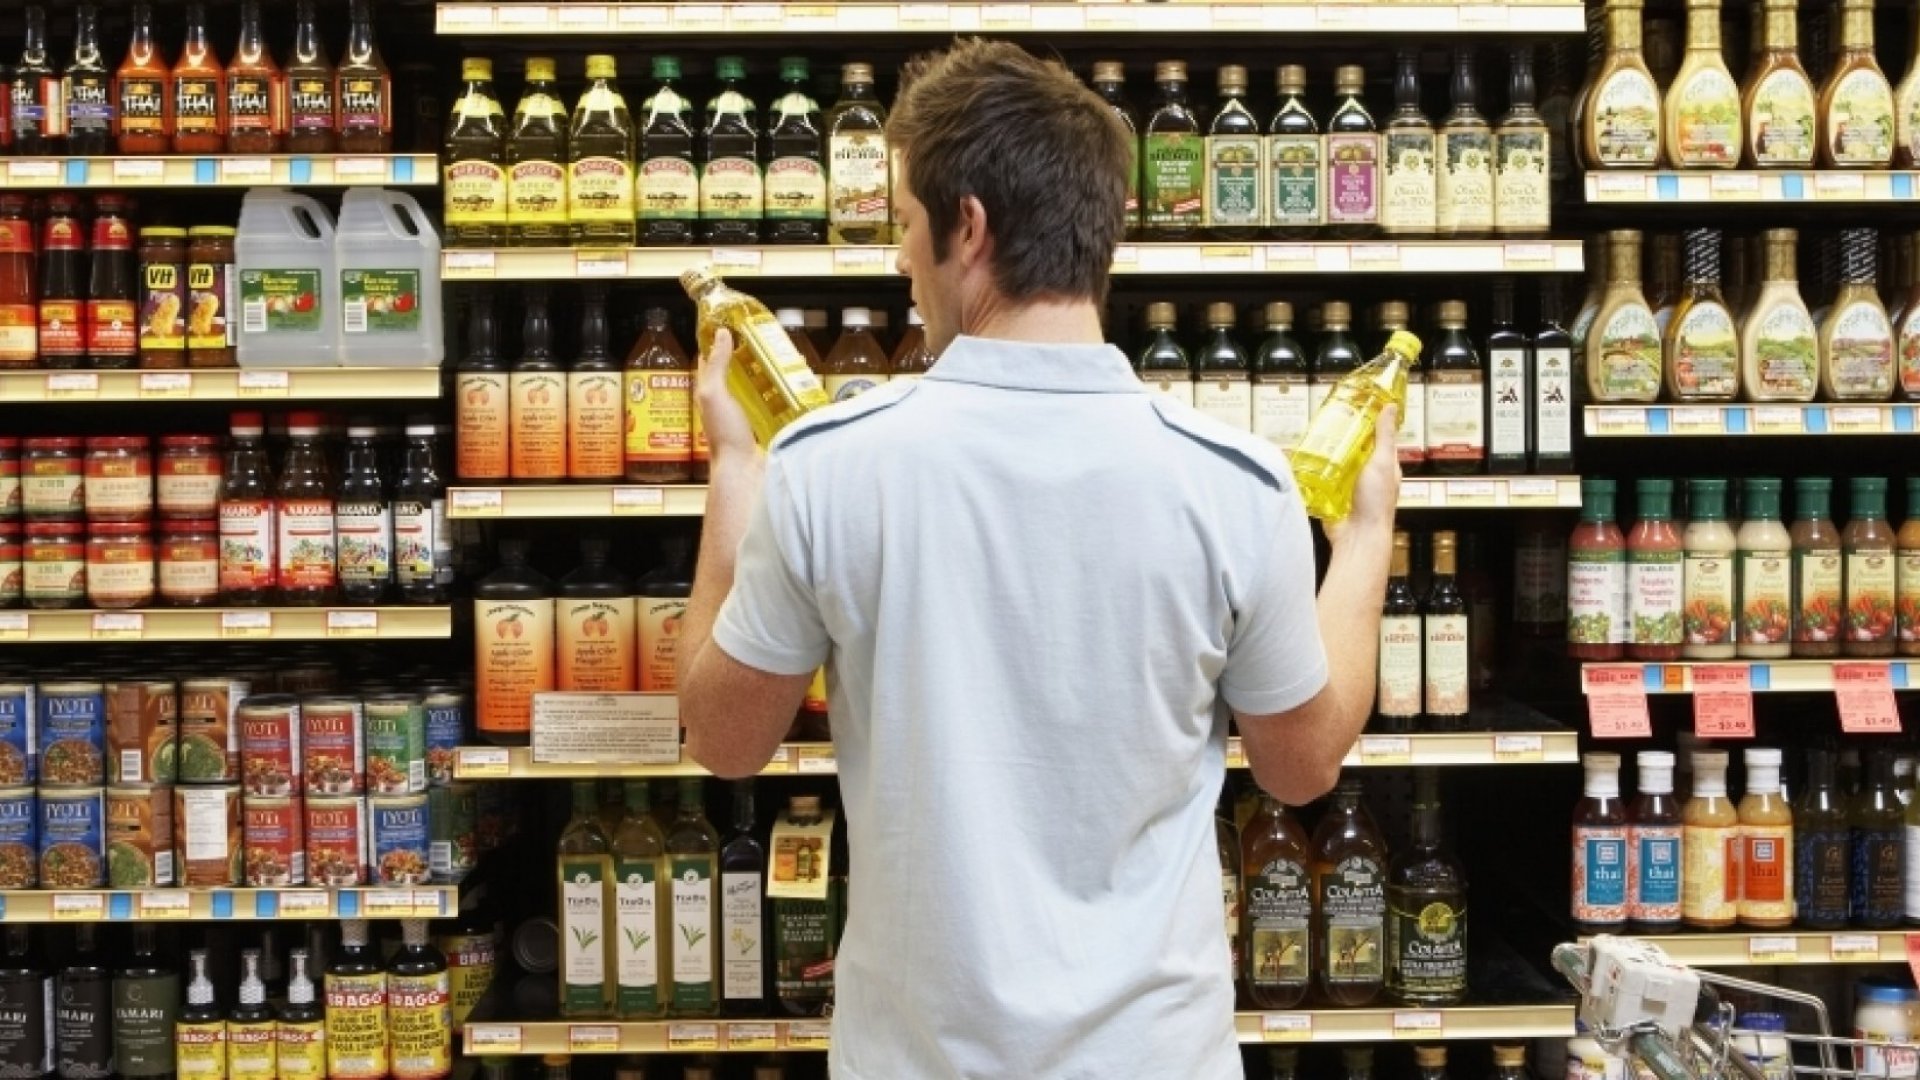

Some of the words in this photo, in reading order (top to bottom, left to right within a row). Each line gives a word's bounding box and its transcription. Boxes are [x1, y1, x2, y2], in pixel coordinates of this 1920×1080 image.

[149, 267, 174, 284] VH
[1594, 866, 1622, 880] thai
[1649, 866, 1674, 880] thai
[1751, 864, 1778, 878] thai
